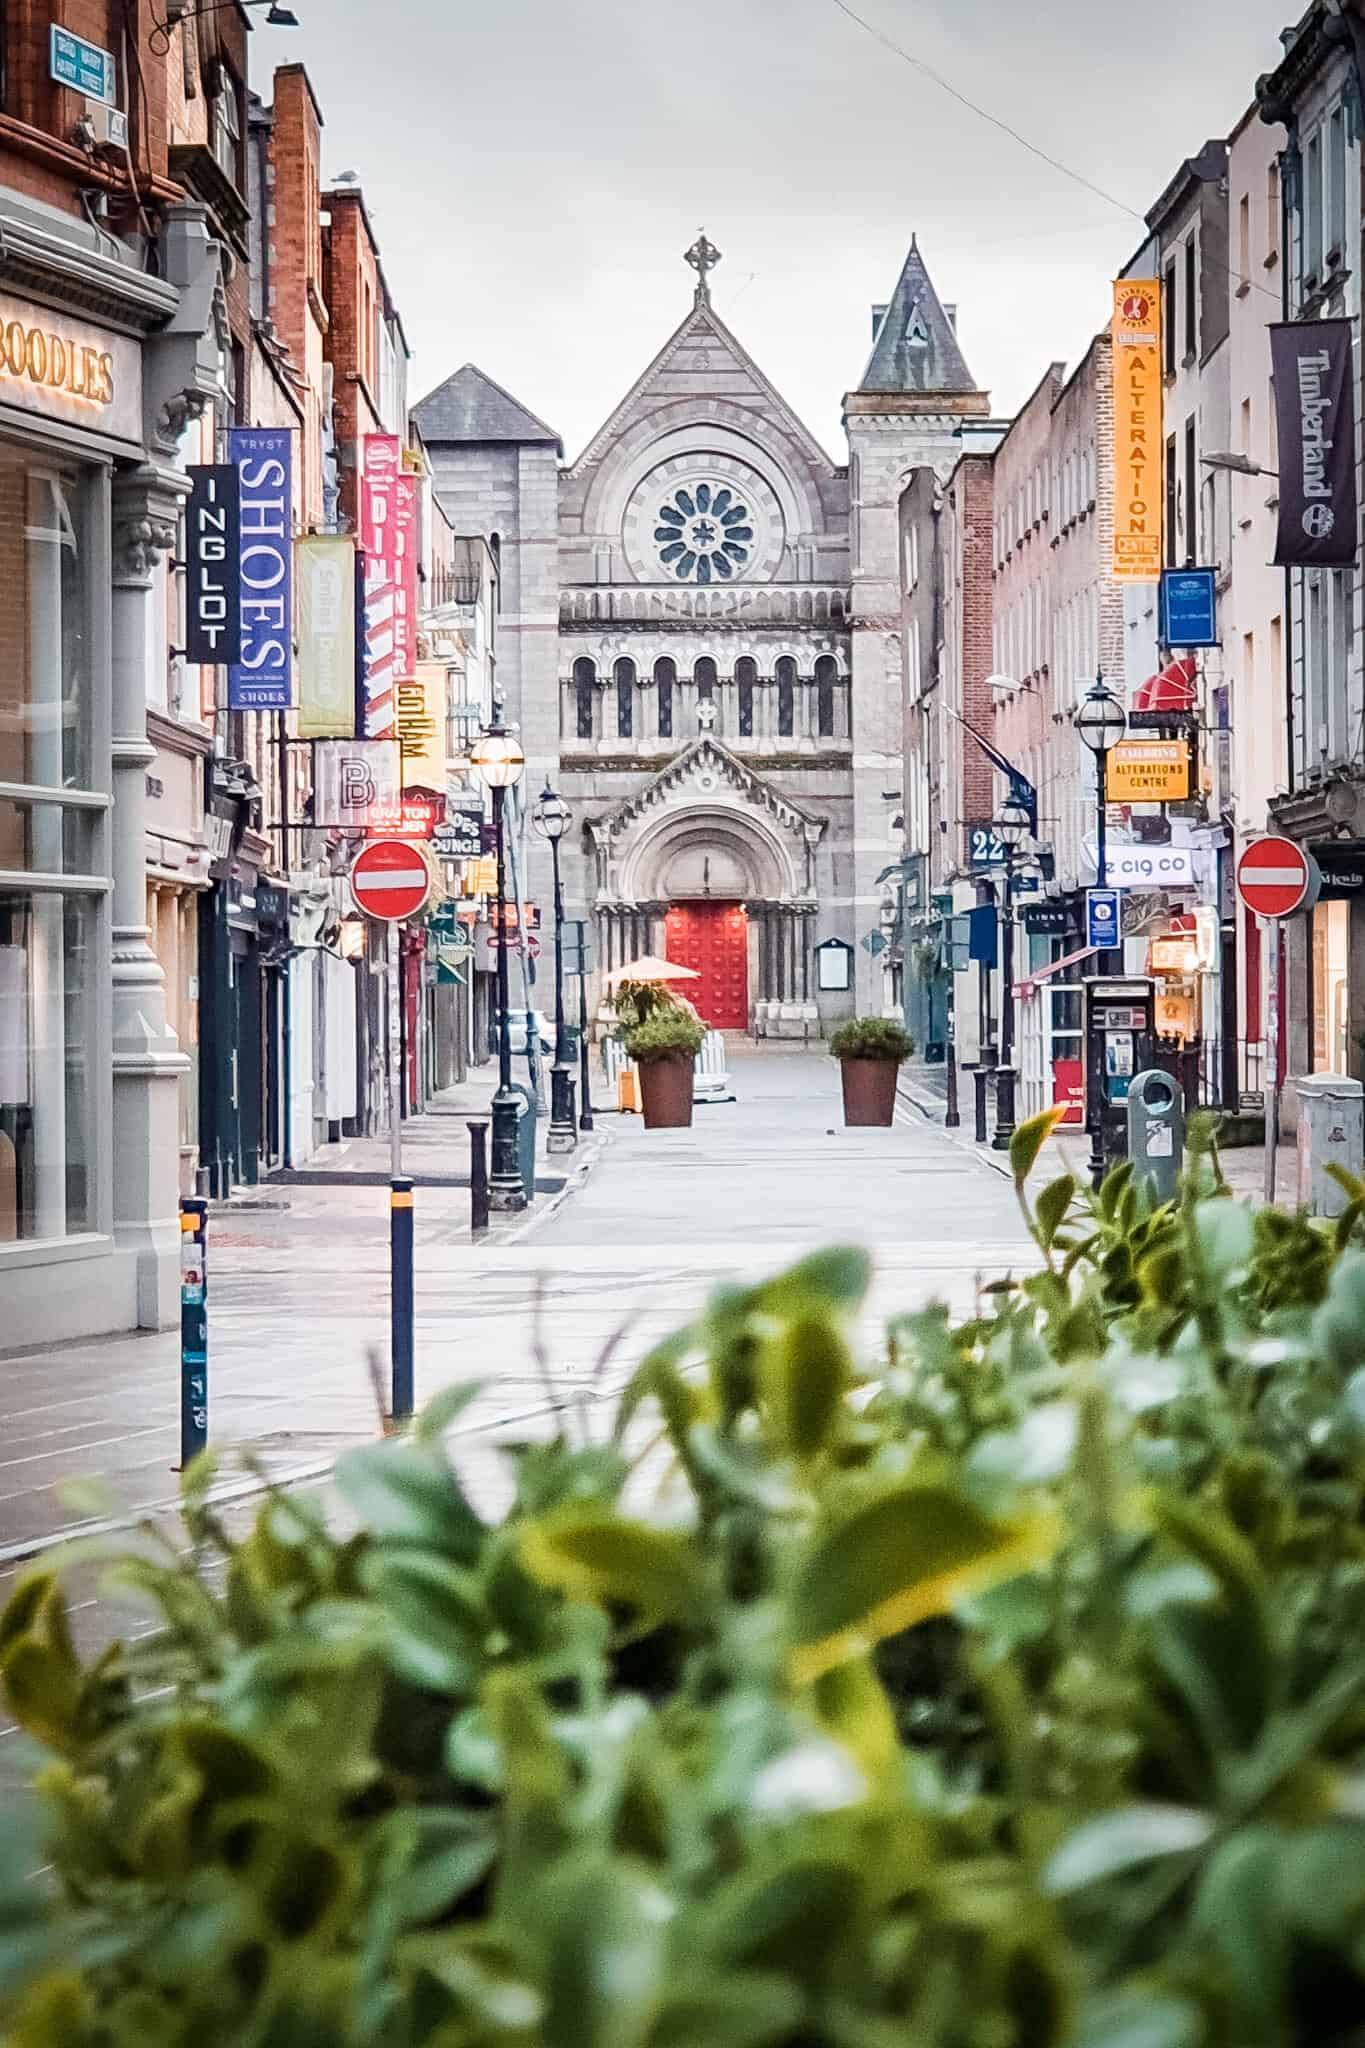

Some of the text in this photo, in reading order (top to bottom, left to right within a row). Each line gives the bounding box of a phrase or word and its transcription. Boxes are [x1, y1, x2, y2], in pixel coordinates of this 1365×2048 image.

[1129, 356, 1148, 533] ALTERATION
[1297, 350, 1333, 498] Timberland
[199, 479, 227, 649] INGLOT
[239, 458, 286, 669] SHOES
[398, 683, 439, 759] GOTHAM
[340, 757, 376, 809] B
[1115, 764, 1184, 775] ALTERATIONS
[1129, 776, 1169, 788] CENTRE
[370, 806, 431, 820] GRATON
[972, 830, 1004, 860] 22
